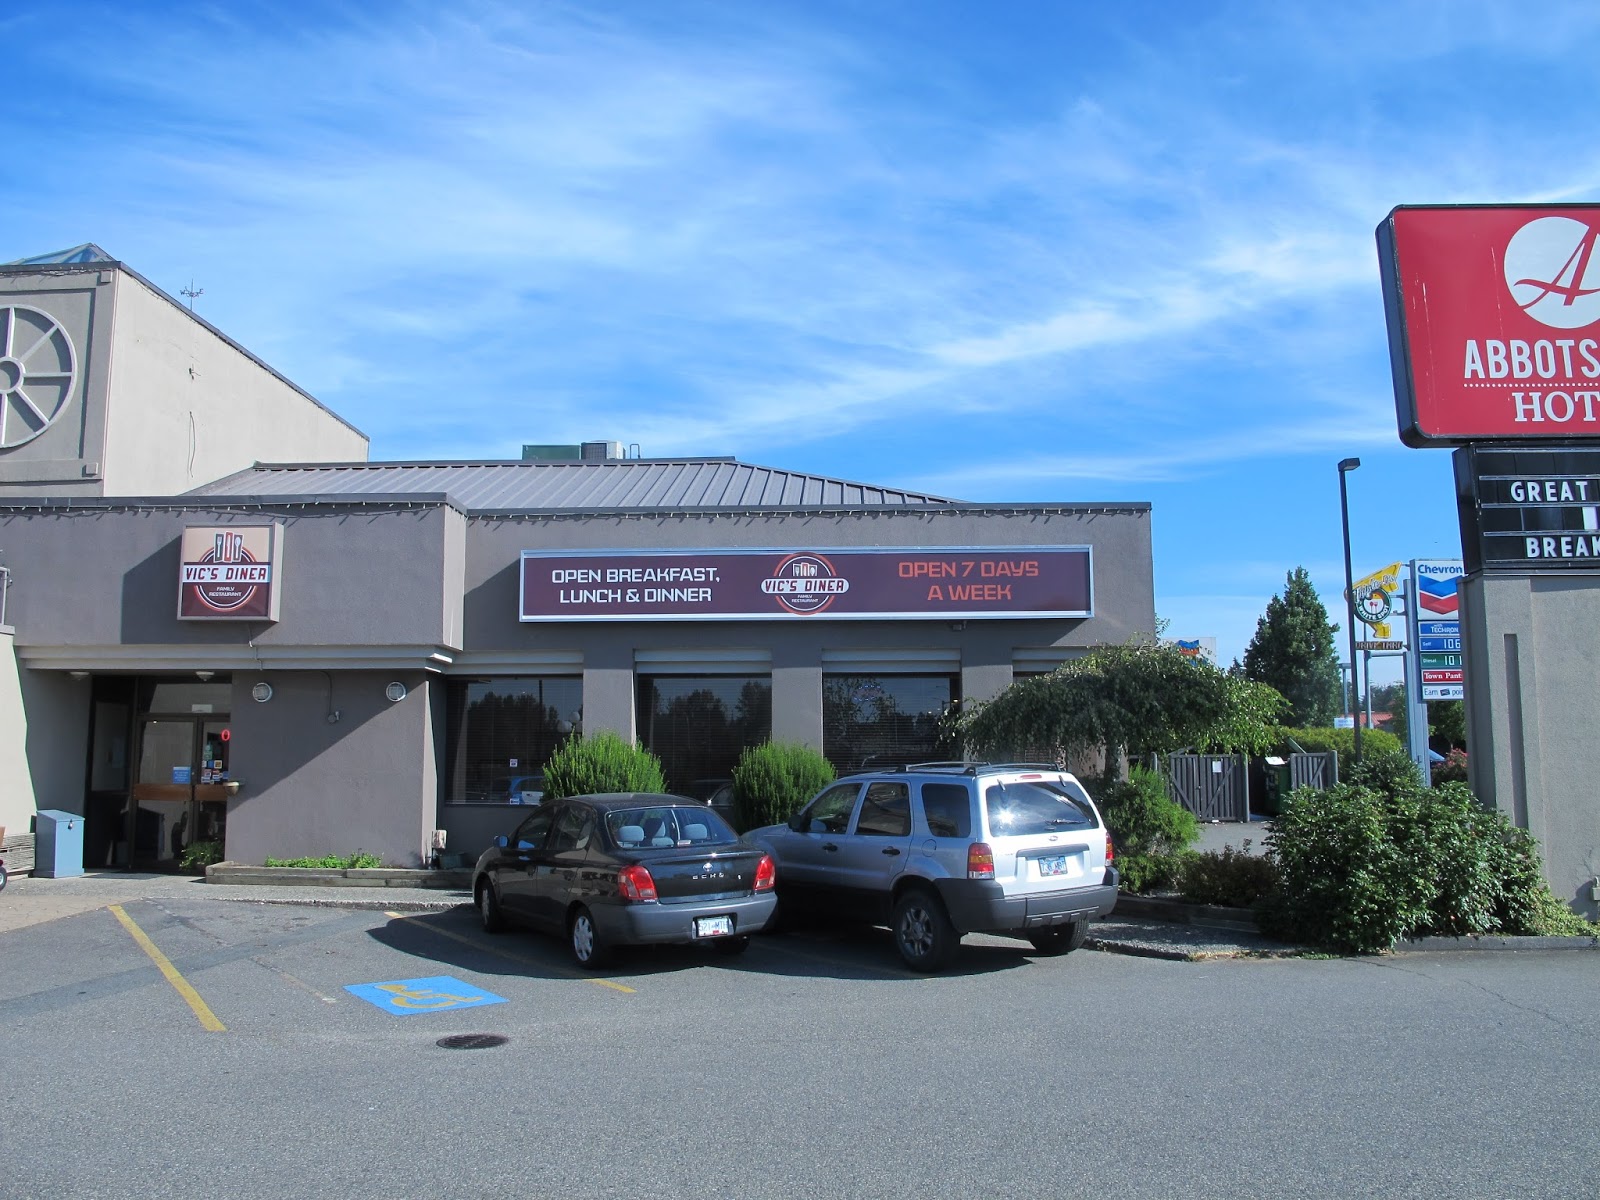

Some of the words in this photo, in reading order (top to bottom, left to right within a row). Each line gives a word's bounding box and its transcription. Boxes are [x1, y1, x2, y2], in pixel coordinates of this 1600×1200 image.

[1464, 339, 1600, 379] ABBOTS
[1512, 391, 1600, 422] HOT
[1510, 481, 1588, 502] GREAT
[1526, 536, 1600, 558] BREAK
[186, 567, 219, 580] VIC'S
[225, 567, 267, 580] DINER
[552, 569, 601, 584] OPEN
[606, 567, 720, 583] BREAKFAST,
[898, 562, 960, 578] OPEN
[961, 561, 975, 577] 7
[980, 561, 1039, 577] DAYS
[1417, 564, 1463, 574] Chevron
[765, 580, 797, 592] VIC'S
[804, 580, 844, 592] DINER
[927, 585, 943, 601] A
[948, 584, 1012, 600] WEEK
[560, 589, 621, 604] LUNCH
[625, 588, 640, 602] &
[644, 587, 712, 602] DINNER
[1358, 605, 1377, 620] WHITE
[1377, 604, 1390, 620] SPOT
[1424, 687, 1439, 696] Earn
